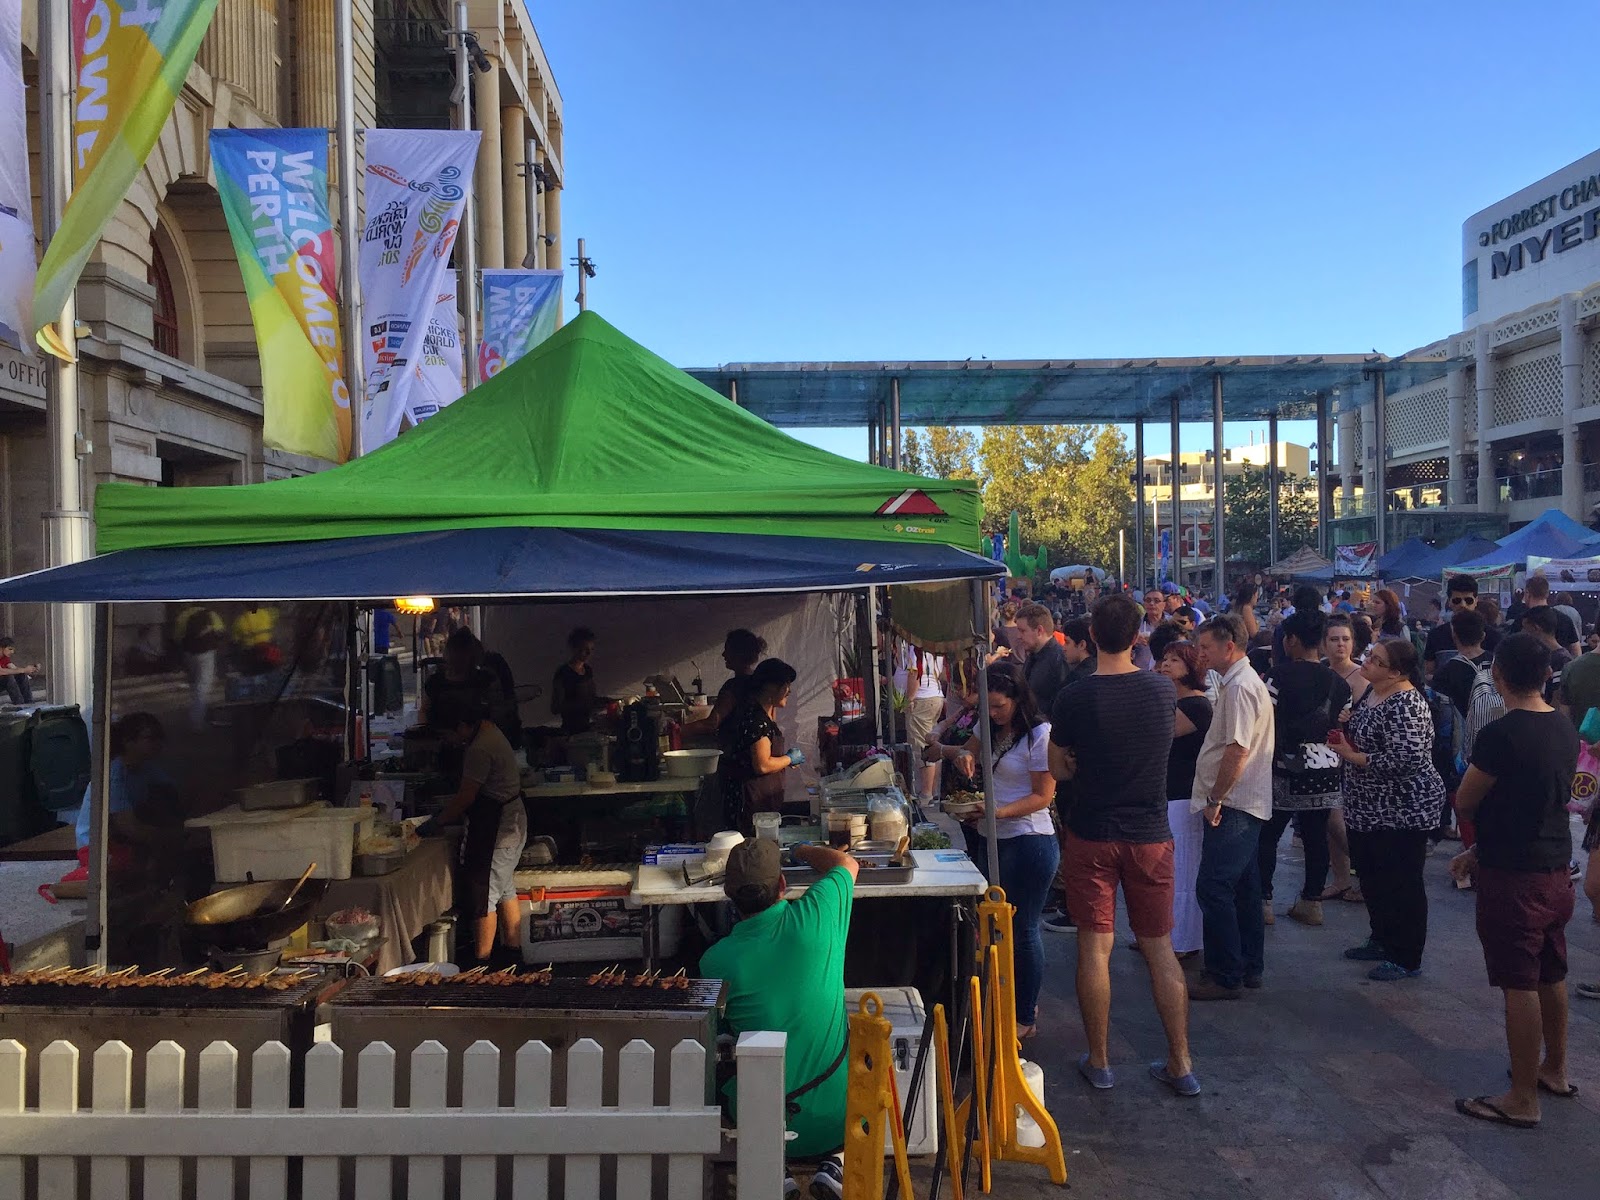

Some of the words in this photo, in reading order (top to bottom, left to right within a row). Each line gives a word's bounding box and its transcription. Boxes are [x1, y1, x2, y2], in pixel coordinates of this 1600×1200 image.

[246, 151, 289, 276] PERTH
[282, 150, 337, 348] WELCOME
[1491, 194, 1558, 245] FORREST
[1560, 172, 1600, 211] CHA
